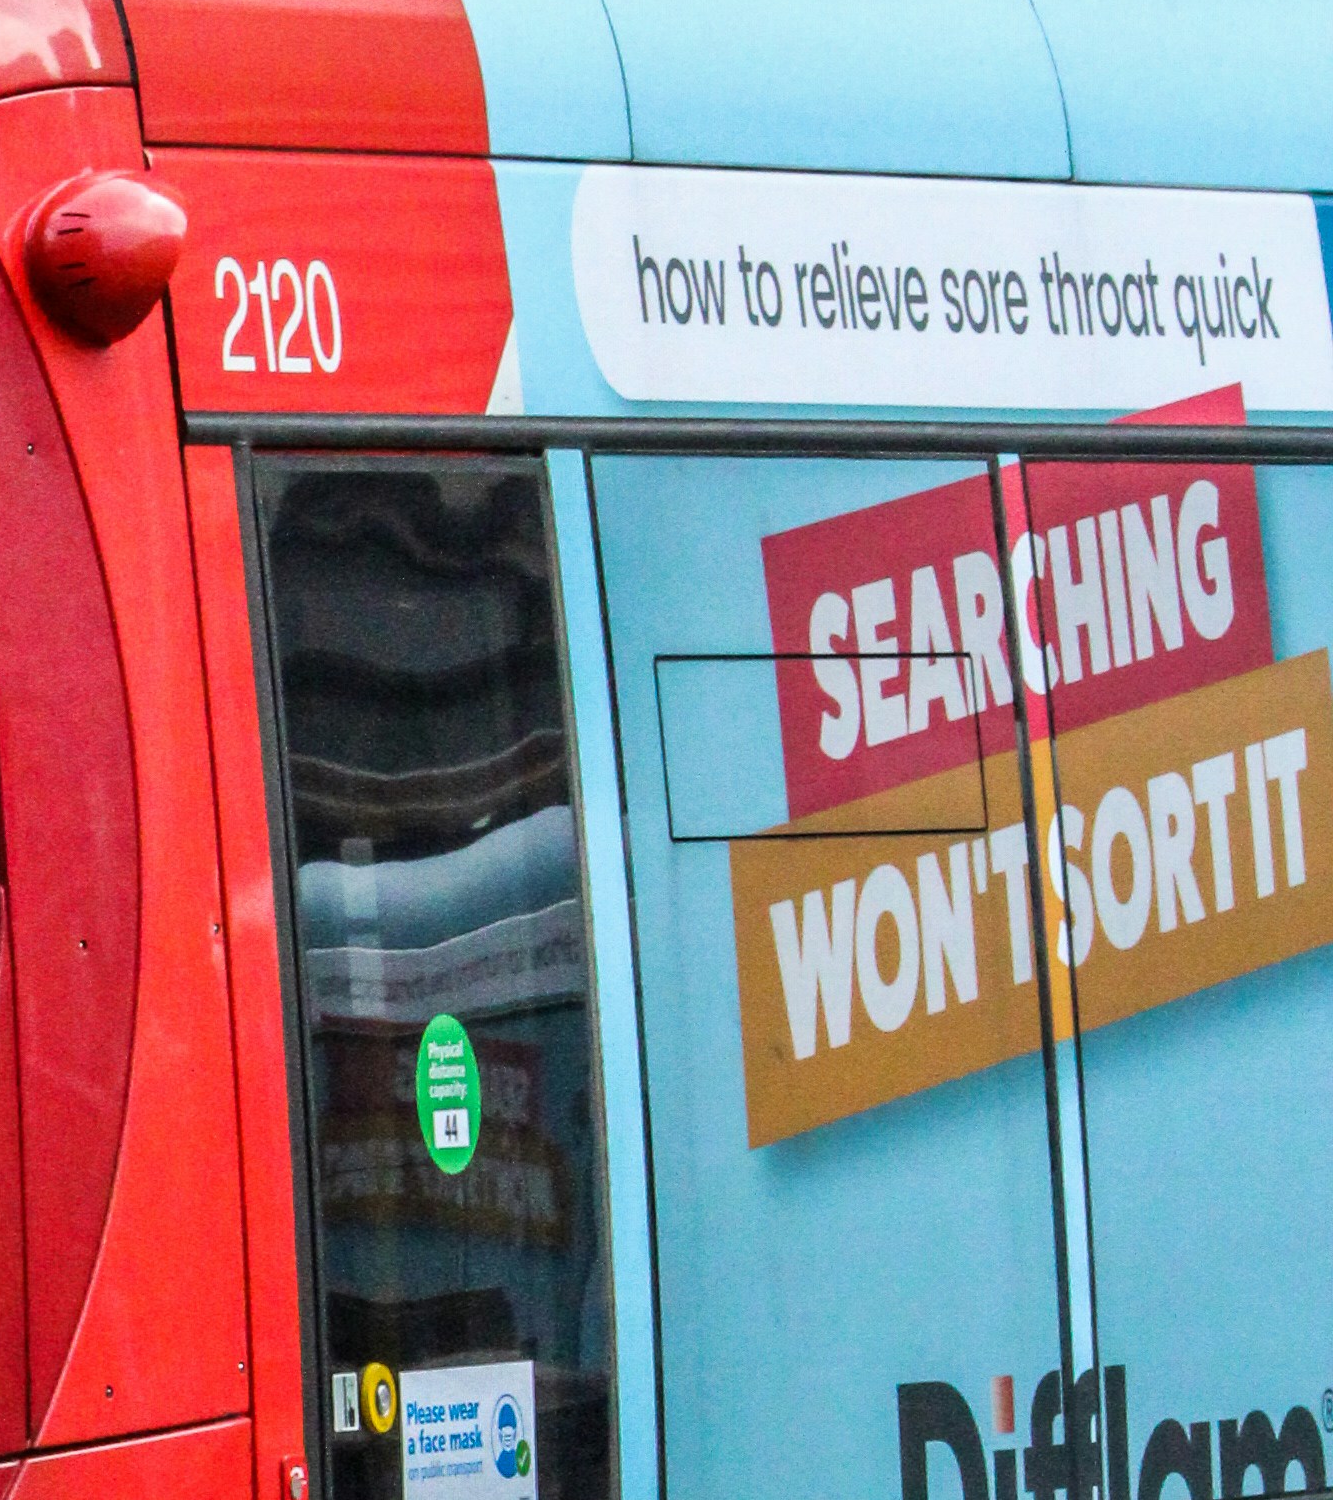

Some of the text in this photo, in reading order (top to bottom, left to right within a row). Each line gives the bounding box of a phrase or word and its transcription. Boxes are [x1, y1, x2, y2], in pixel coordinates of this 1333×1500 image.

[214, 257, 343, 374] 2120
[633, 235, 1280, 365] how to relieve sore throat quick
[808, 479, 1235, 760] SEARCHING
[769, 727, 1308, 1060] WON'T SORT IT
[427, 1040, 464, 1063] Physical
[445, 1113, 458, 1143] 44
[406, 1400, 479, 1426] Please wear
[408, 1424, 483, 1455] a face mask
[408, 1467, 420, 1481] on
